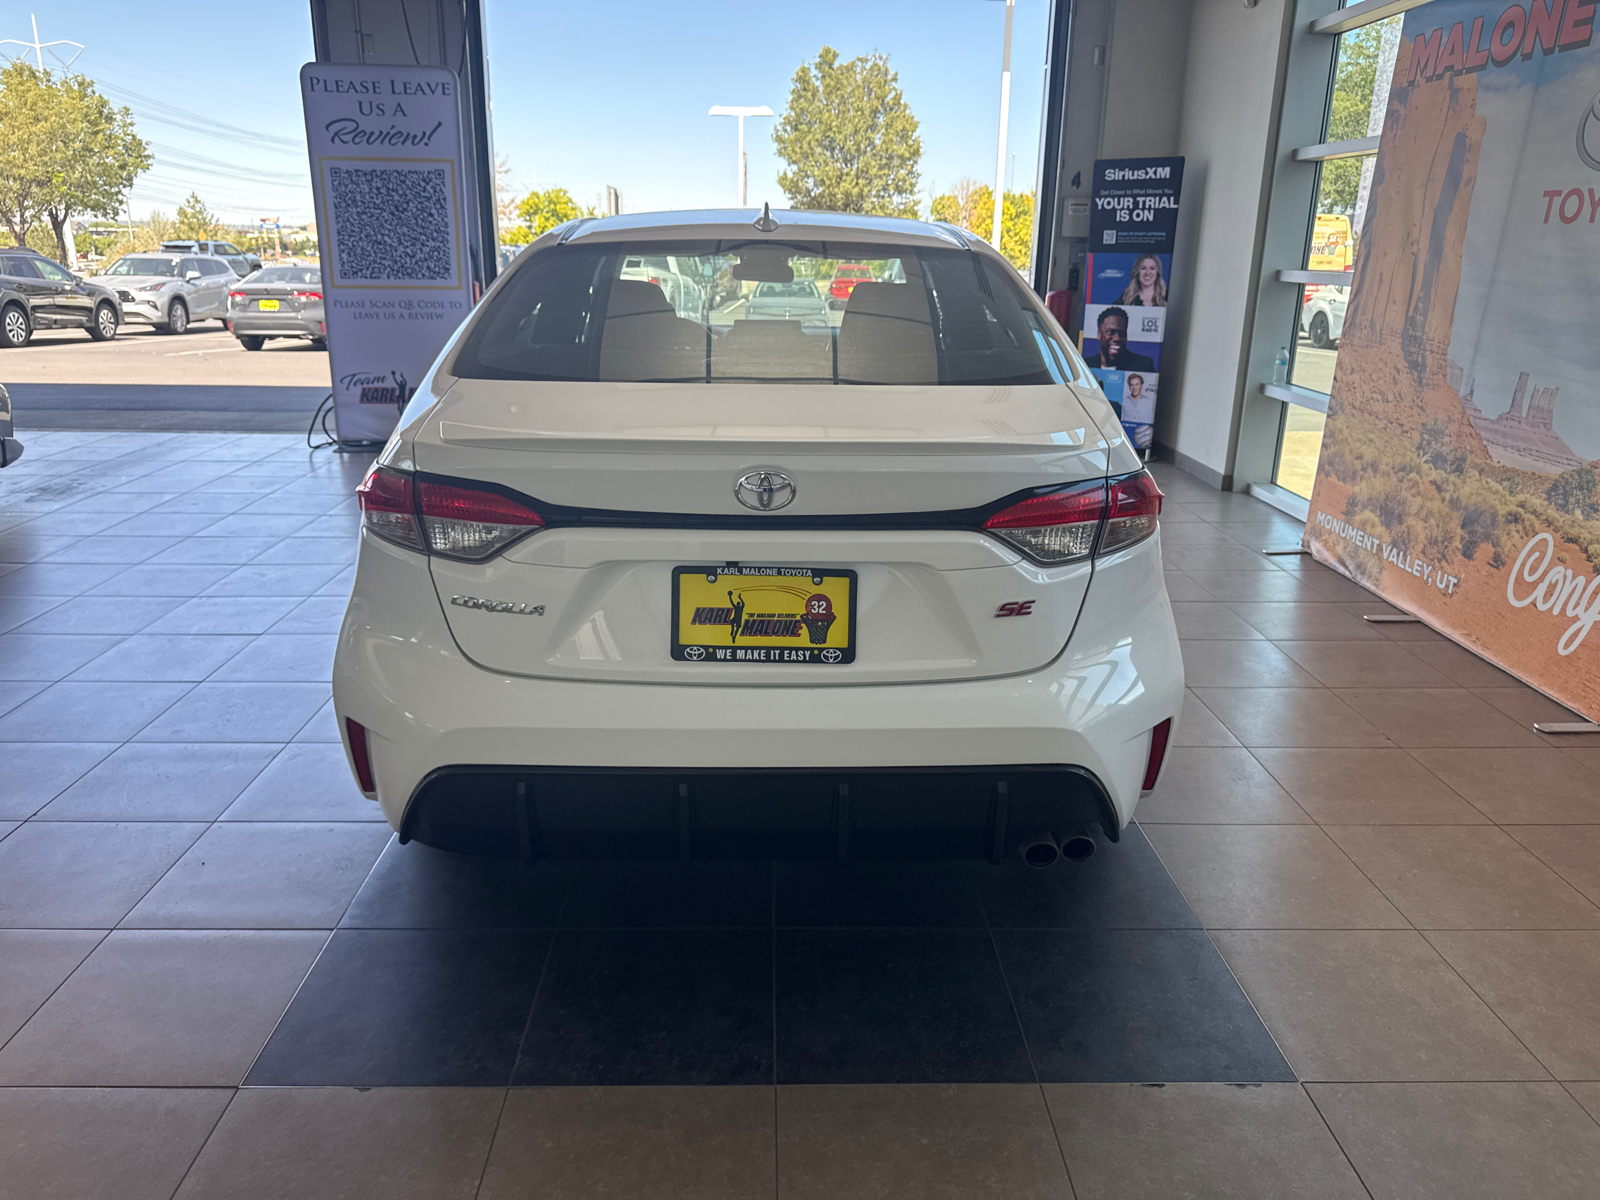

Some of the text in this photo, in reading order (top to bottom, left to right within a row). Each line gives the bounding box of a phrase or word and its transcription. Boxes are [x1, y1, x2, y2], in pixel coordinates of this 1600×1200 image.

[1407, 0, 1597, 87] MALONE
[308, 76, 451, 96] PLEASE LEAVE
[357, 100, 408, 117] US A
[325, 118, 443, 147] Review!
[1071, 170, 1081, 190] 4
[1104, 167, 1171, 181] SiriusXM
[1095, 196, 1178, 210] YOUR TRIAL
[1116, 209, 1154, 222] IS ON
[333, 300, 462, 311] PLEASE SCAN QR CODE TO
[353, 312, 380, 320] LEAVE
[408, 313, 444, 321] REVIEW
[1142, 320, 1158, 328] LOL
[340, 371, 389, 391] Team
[1315, 510, 1458, 594] MONUMENT VALLEY, UT
[716, 567, 812, 577] KARL MALONE TOYOTA
[450, 594, 545, 616] COROLLA
[811, 601, 826, 614] 32
[994, 600, 1036, 618] SE
[691, 607, 733, 625] KARL
[740, 619, 803, 637] MALONE
[716, 649, 810, 660] WE MAKE IT EASY
